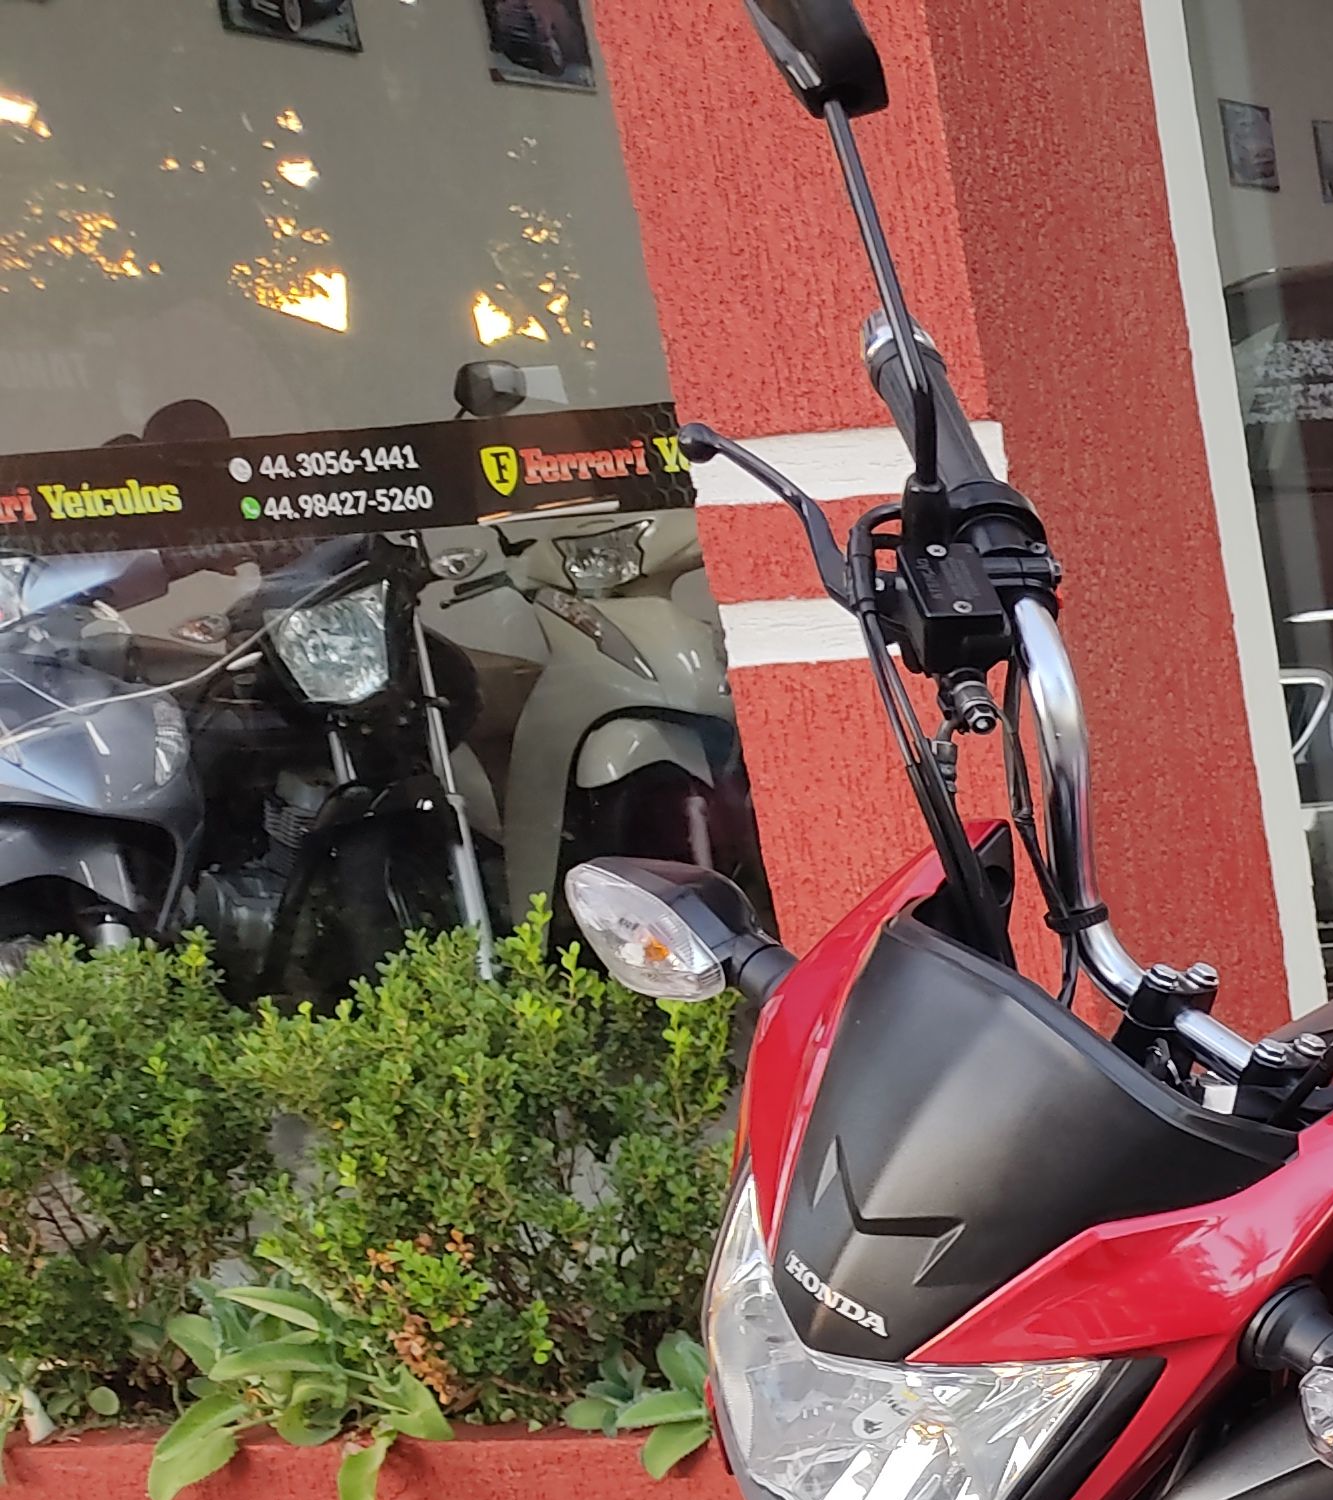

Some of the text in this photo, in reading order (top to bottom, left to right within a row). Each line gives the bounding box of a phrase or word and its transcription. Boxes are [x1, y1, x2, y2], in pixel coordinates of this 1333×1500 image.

[259, 444, 420, 482] 44.3056-1441
[519, 439, 650, 485] Ferrari
[264, 486, 433, 521] 44.98427-5260
[784, 1249, 889, 1338] HONDA
